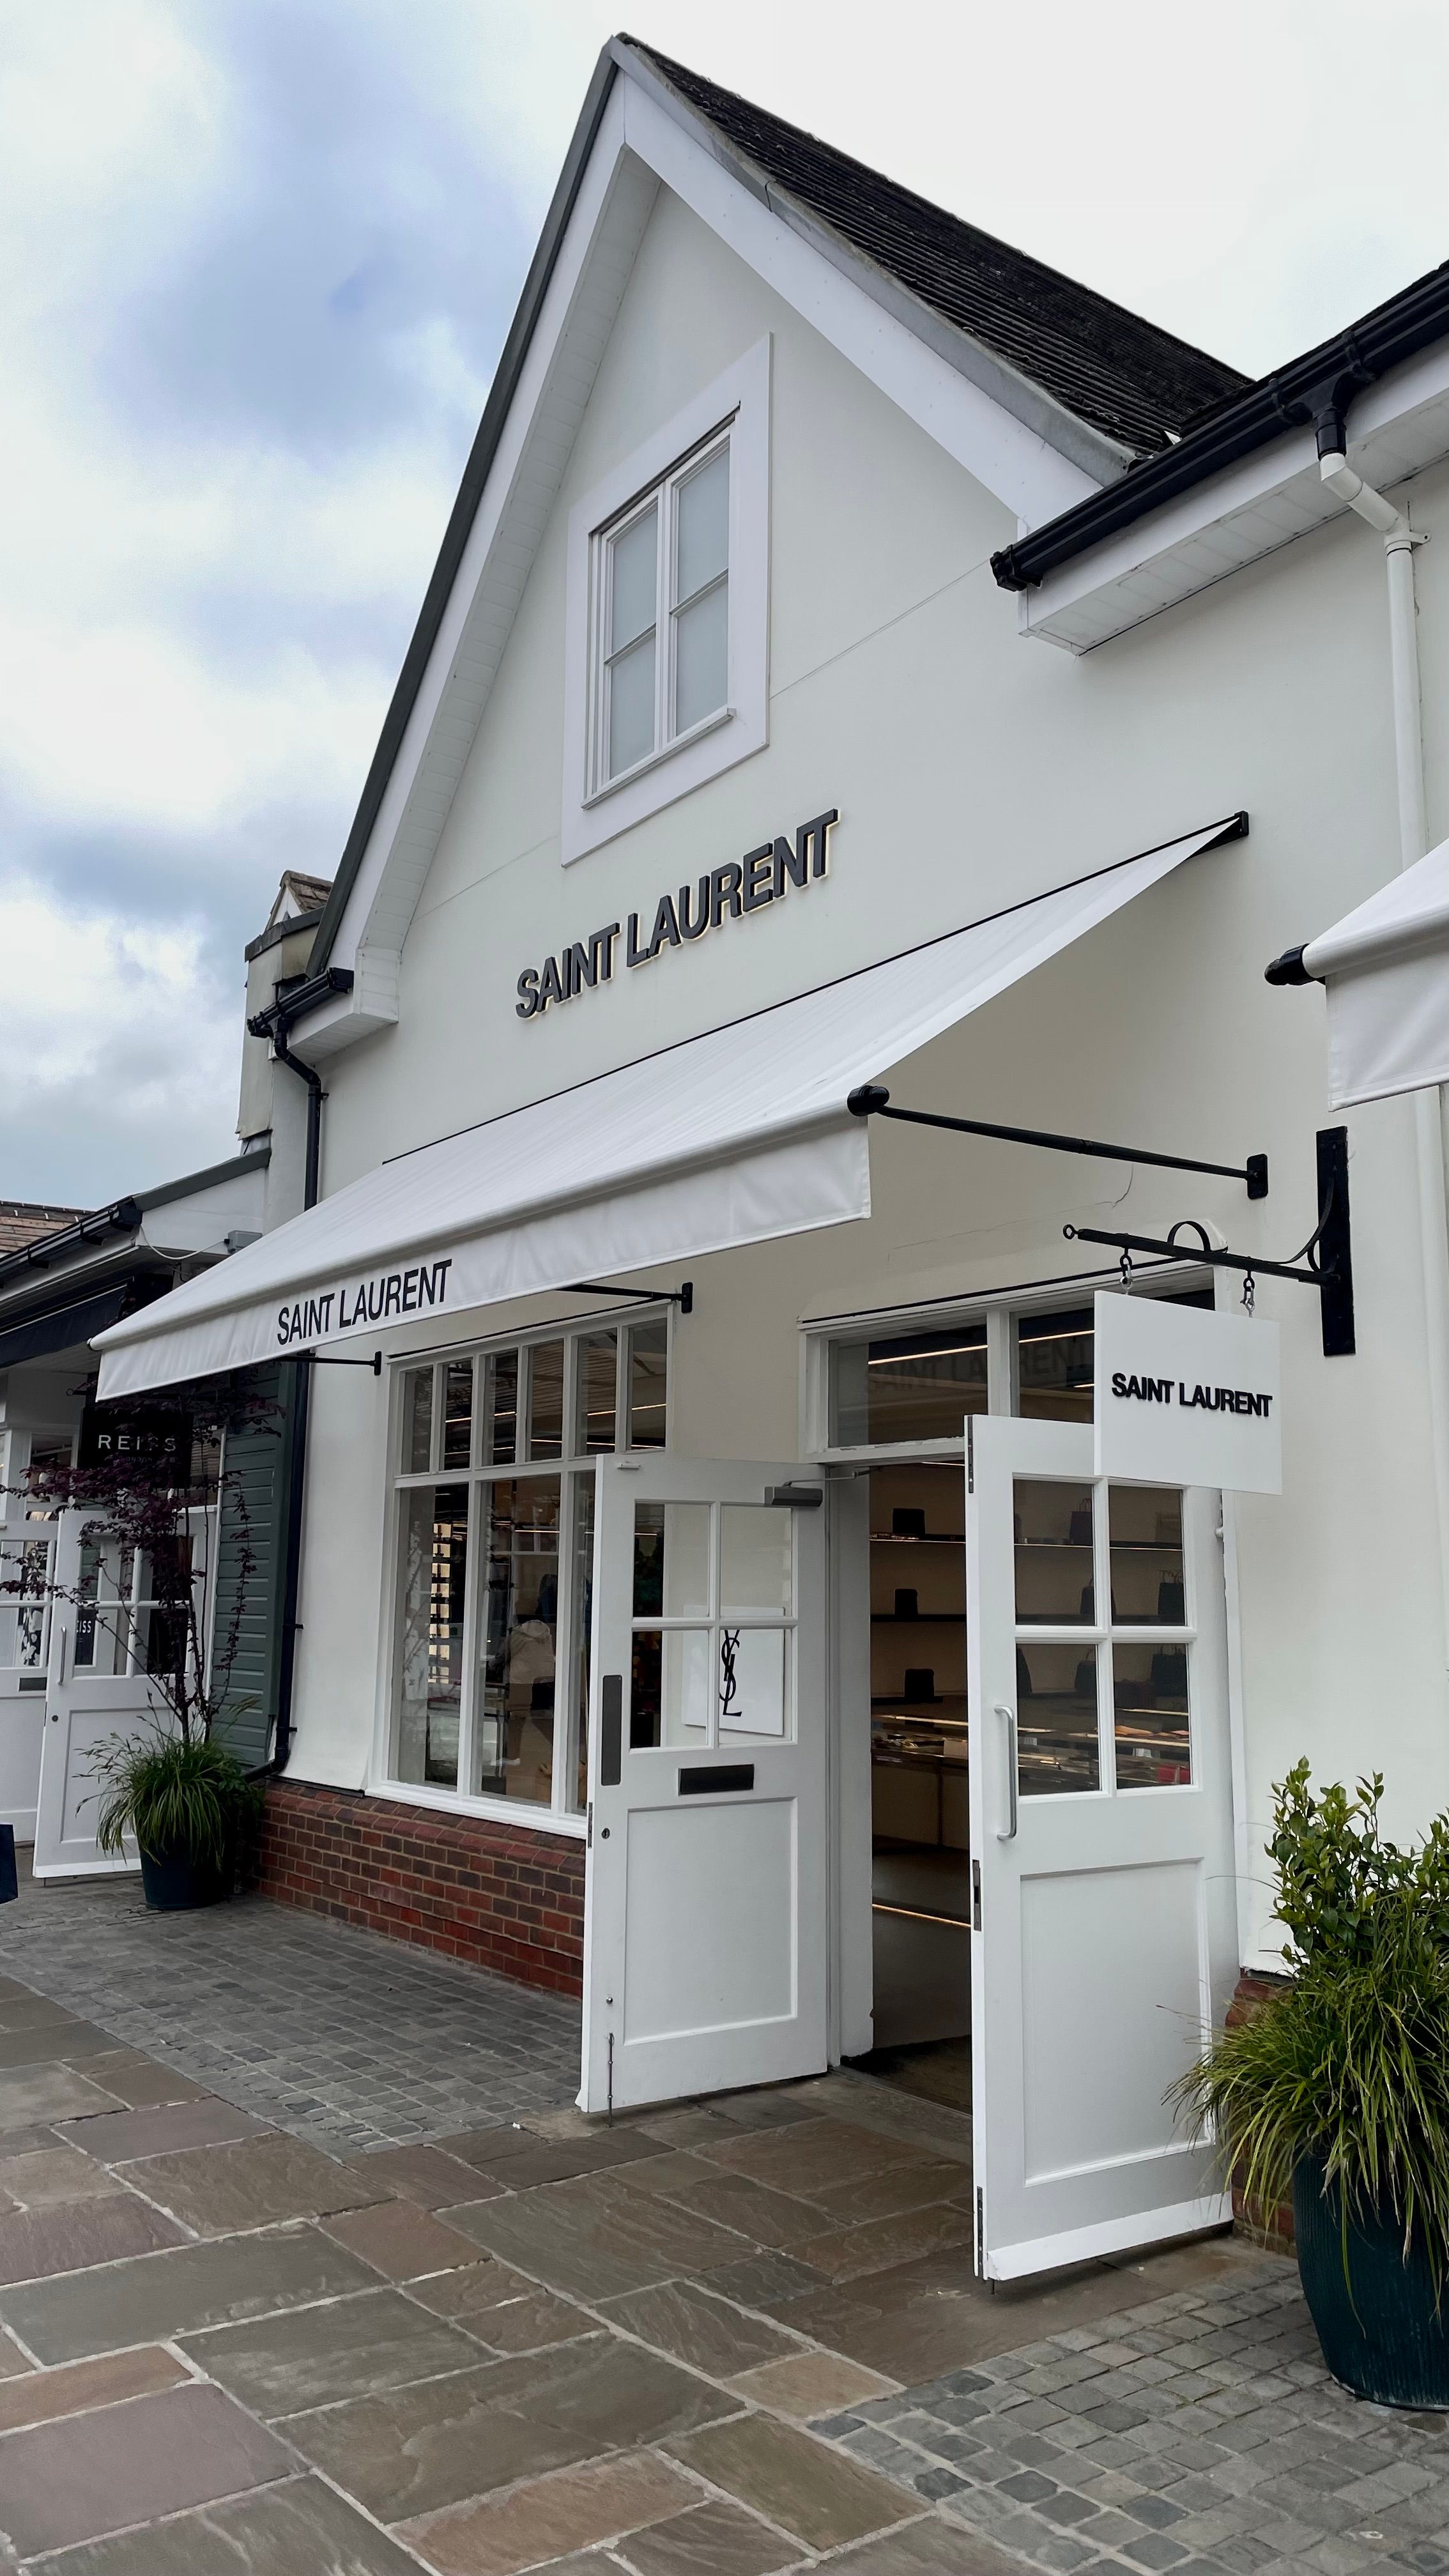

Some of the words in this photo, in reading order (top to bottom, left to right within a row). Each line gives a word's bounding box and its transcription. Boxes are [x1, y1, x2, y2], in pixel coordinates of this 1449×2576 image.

[516, 923, 620, 1018] SAINT
[627, 808, 839, 968] LAURENT
[277, 1292, 335, 1345] SAINT
[339, 1259, 452, 1328] LAURENT
[1112, 1372, 1174, 1403] SAINT
[1179, 1382, 1273, 1416] LAURENT
